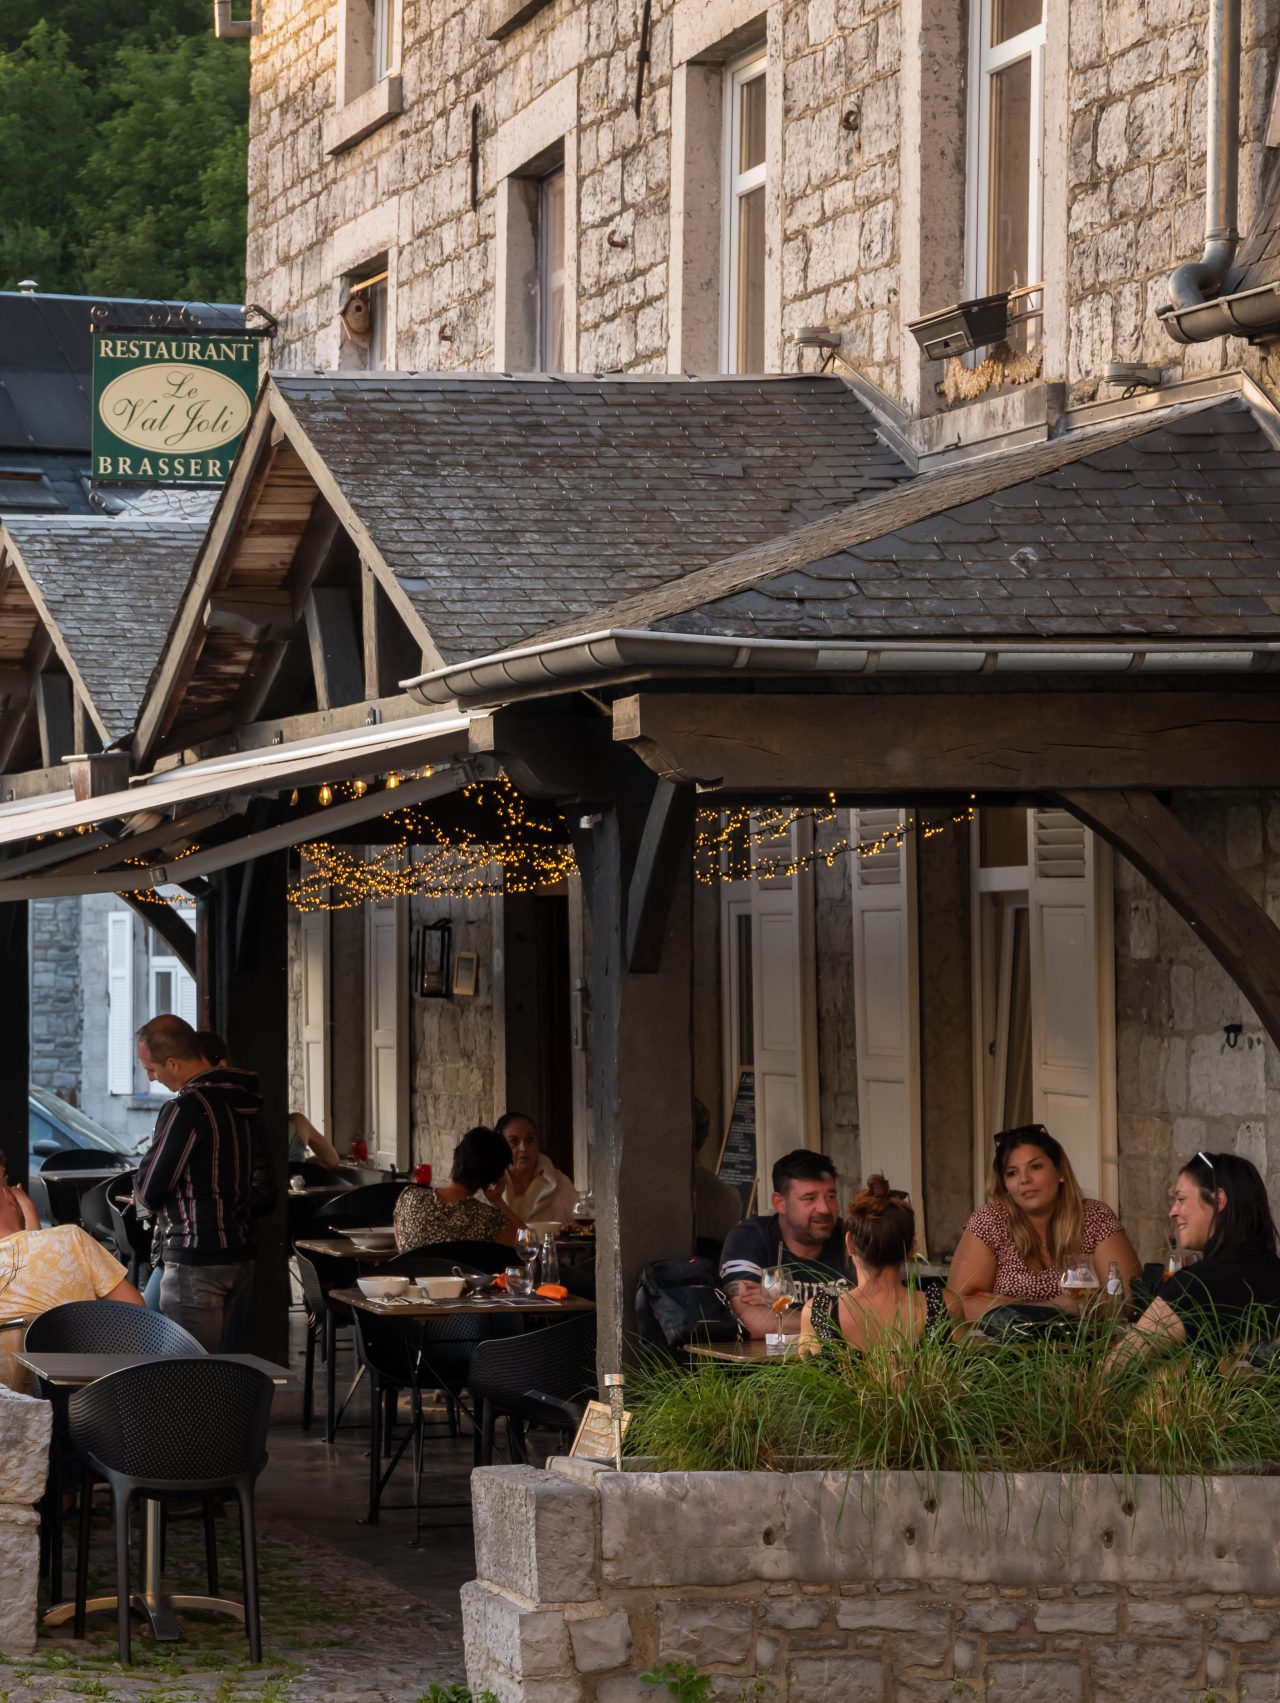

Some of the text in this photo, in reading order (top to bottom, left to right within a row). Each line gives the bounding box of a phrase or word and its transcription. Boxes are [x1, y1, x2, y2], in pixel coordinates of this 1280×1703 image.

[99, 339, 254, 362] RESTAURANT
[162, 370, 198, 399] Le
[112, 398, 234, 446] Val Joli
